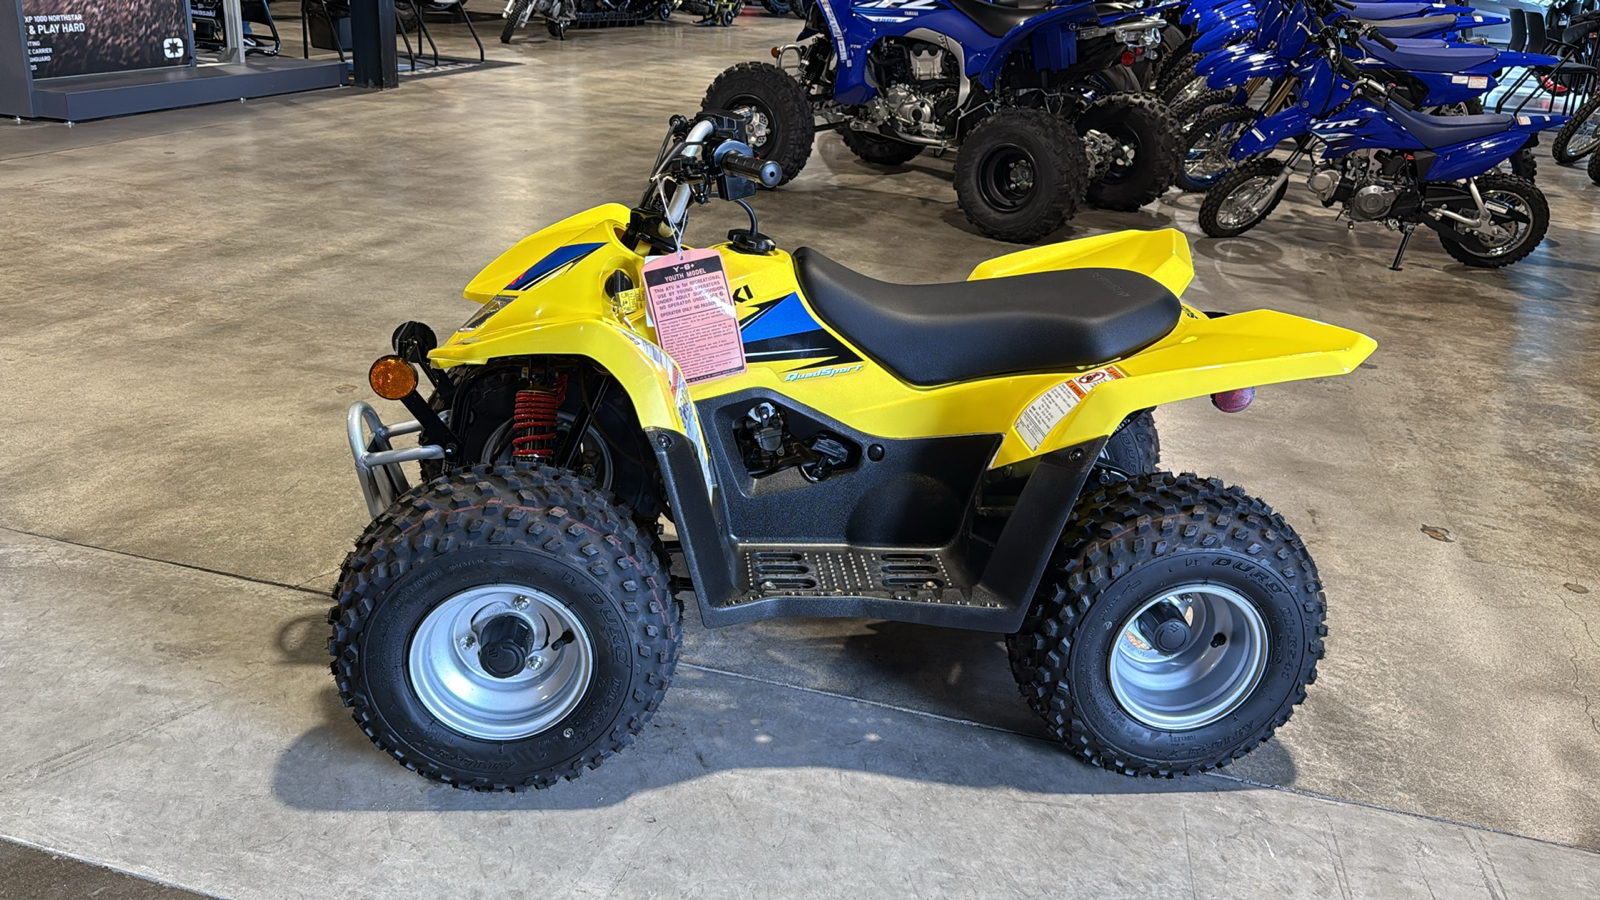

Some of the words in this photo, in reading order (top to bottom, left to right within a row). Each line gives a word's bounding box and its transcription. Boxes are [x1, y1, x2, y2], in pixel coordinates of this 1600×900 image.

[29, 25, 36, 34] &
[38, 24, 60, 34] PLAY
[62, 22, 85, 32] HARD
[664, 273, 684, 282] YOUTH
[686, 268, 706, 277] MODEL
[667, 299, 691, 308] OPERATOR
[660, 309, 681, 317] OPERATOR
[784, 364, 863, 382] QuadSport
[1212, 556, 1282, 594] DURO
